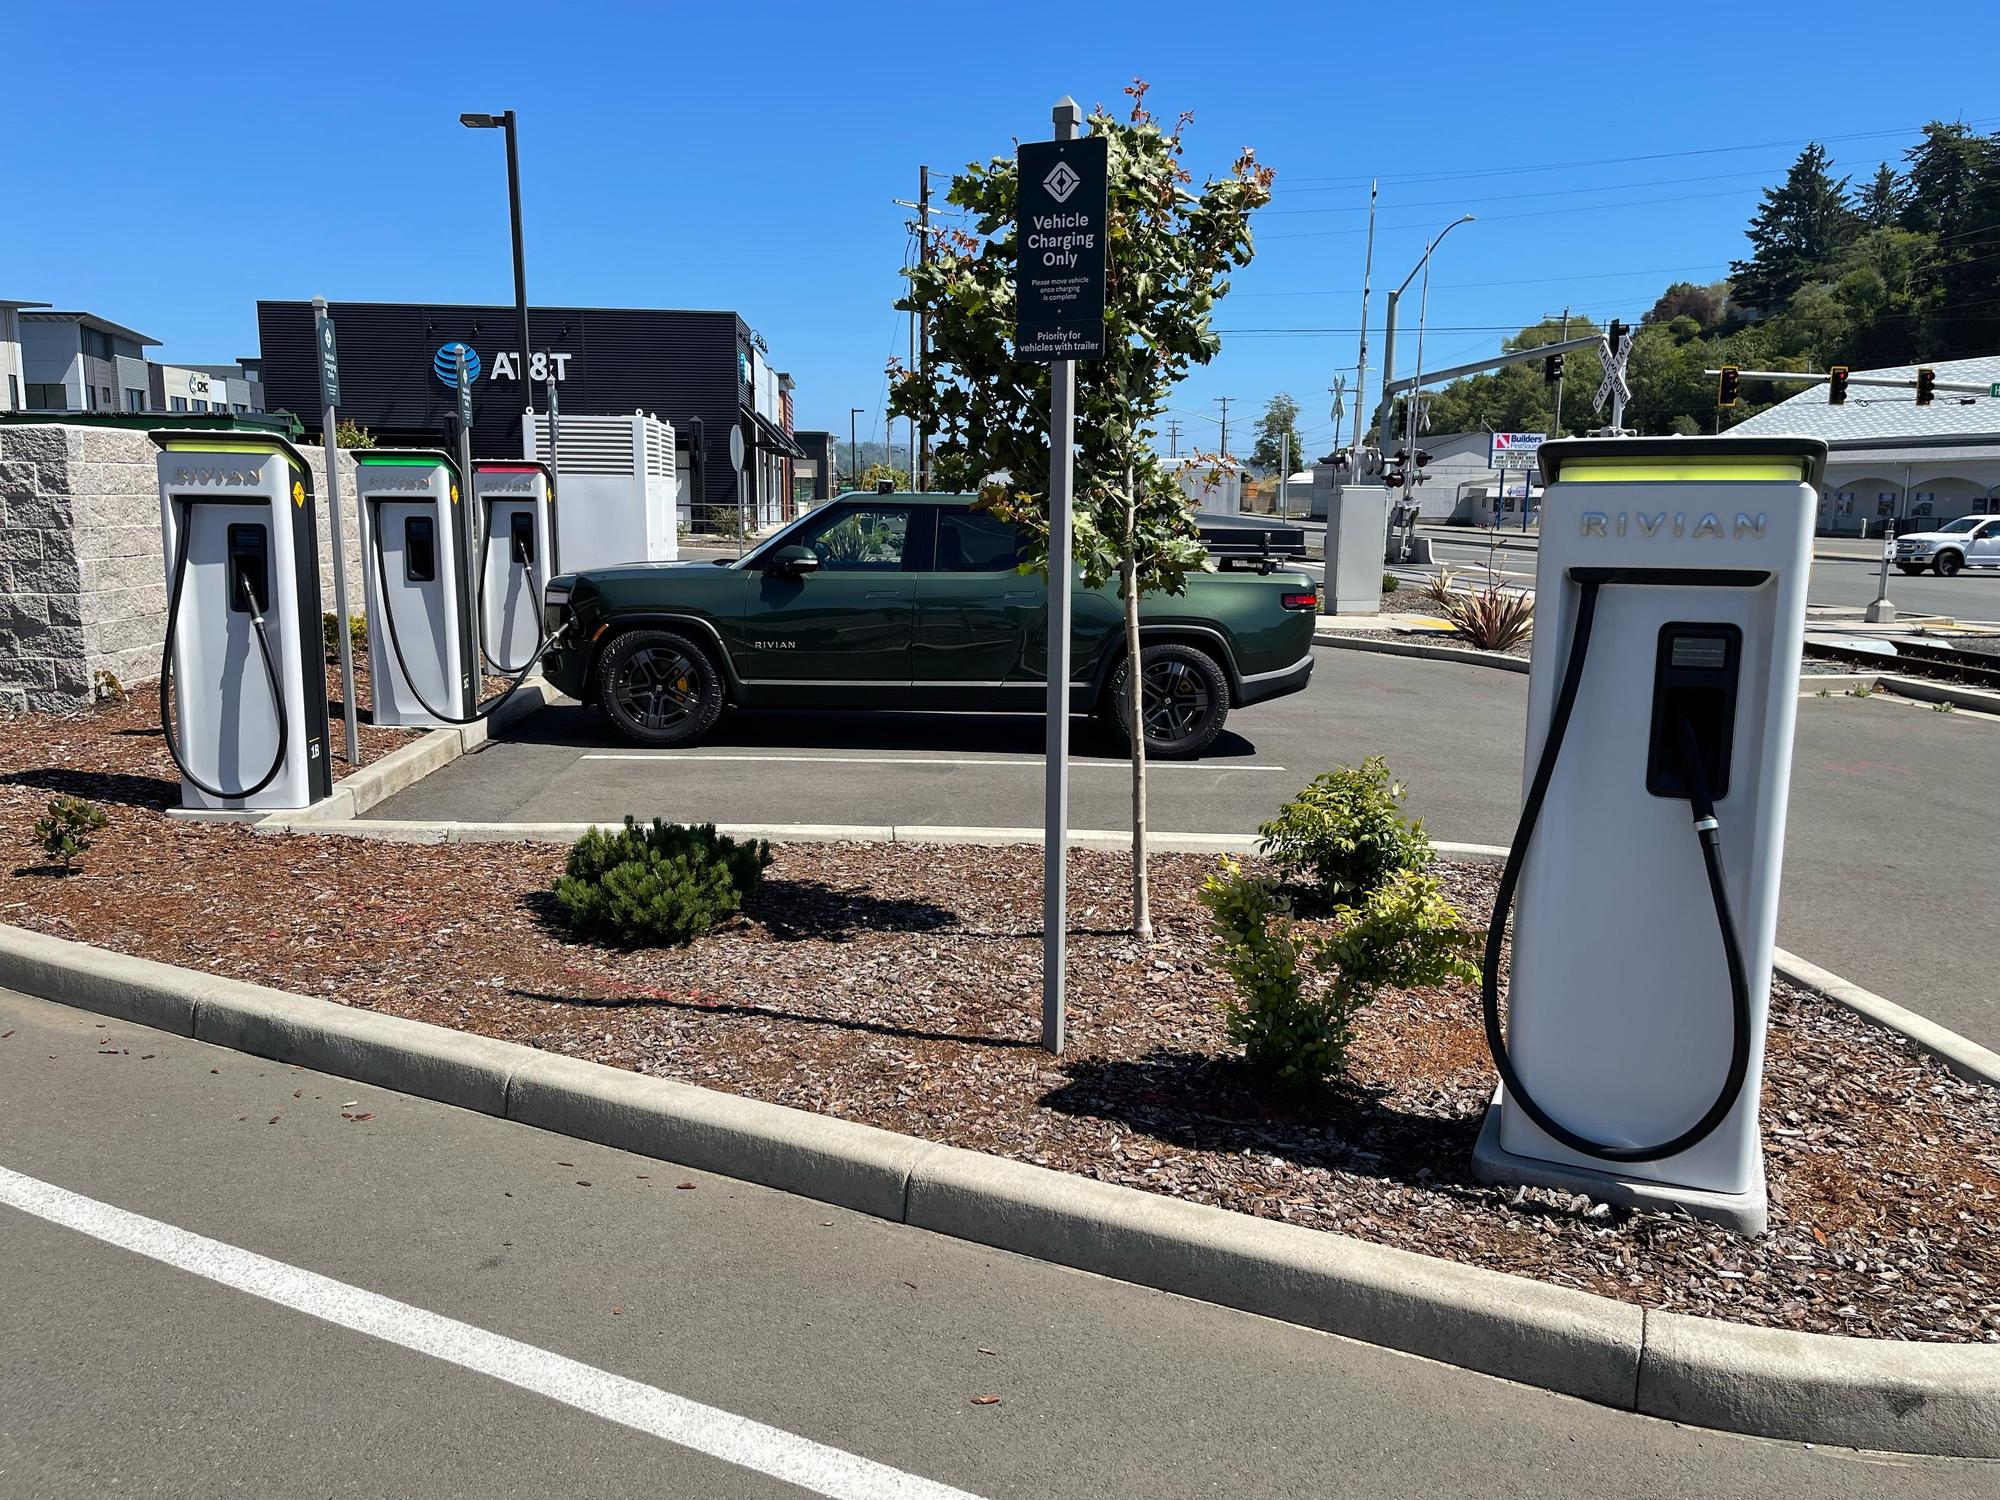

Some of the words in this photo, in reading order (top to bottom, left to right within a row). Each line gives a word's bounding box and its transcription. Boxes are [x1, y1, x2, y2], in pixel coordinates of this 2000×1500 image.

[1033, 212, 1089, 230] Vehicle
[1028, 231, 1095, 250] Charging
[1043, 251, 1078, 268] Only
[1068, 276, 1089, 284] vehicle
[1056, 285, 1080, 293] charging
[1049, 293, 1077, 301] complete
[1037, 331, 1068, 342] Priority
[1069, 330, 1081, 340] for
[1020, 343, 1053, 352] vehicles
[1054, 341, 1073, 351] with
[1073, 341, 1099, 350] trailer
[1512, 435, 1543, 443] Builders
[176, 466, 262, 482] RIVIAN
[1580, 512, 1768, 539] RIVIAN
[754, 641, 796, 649] RIVIAN
[310, 743, 320, 760] 1B
